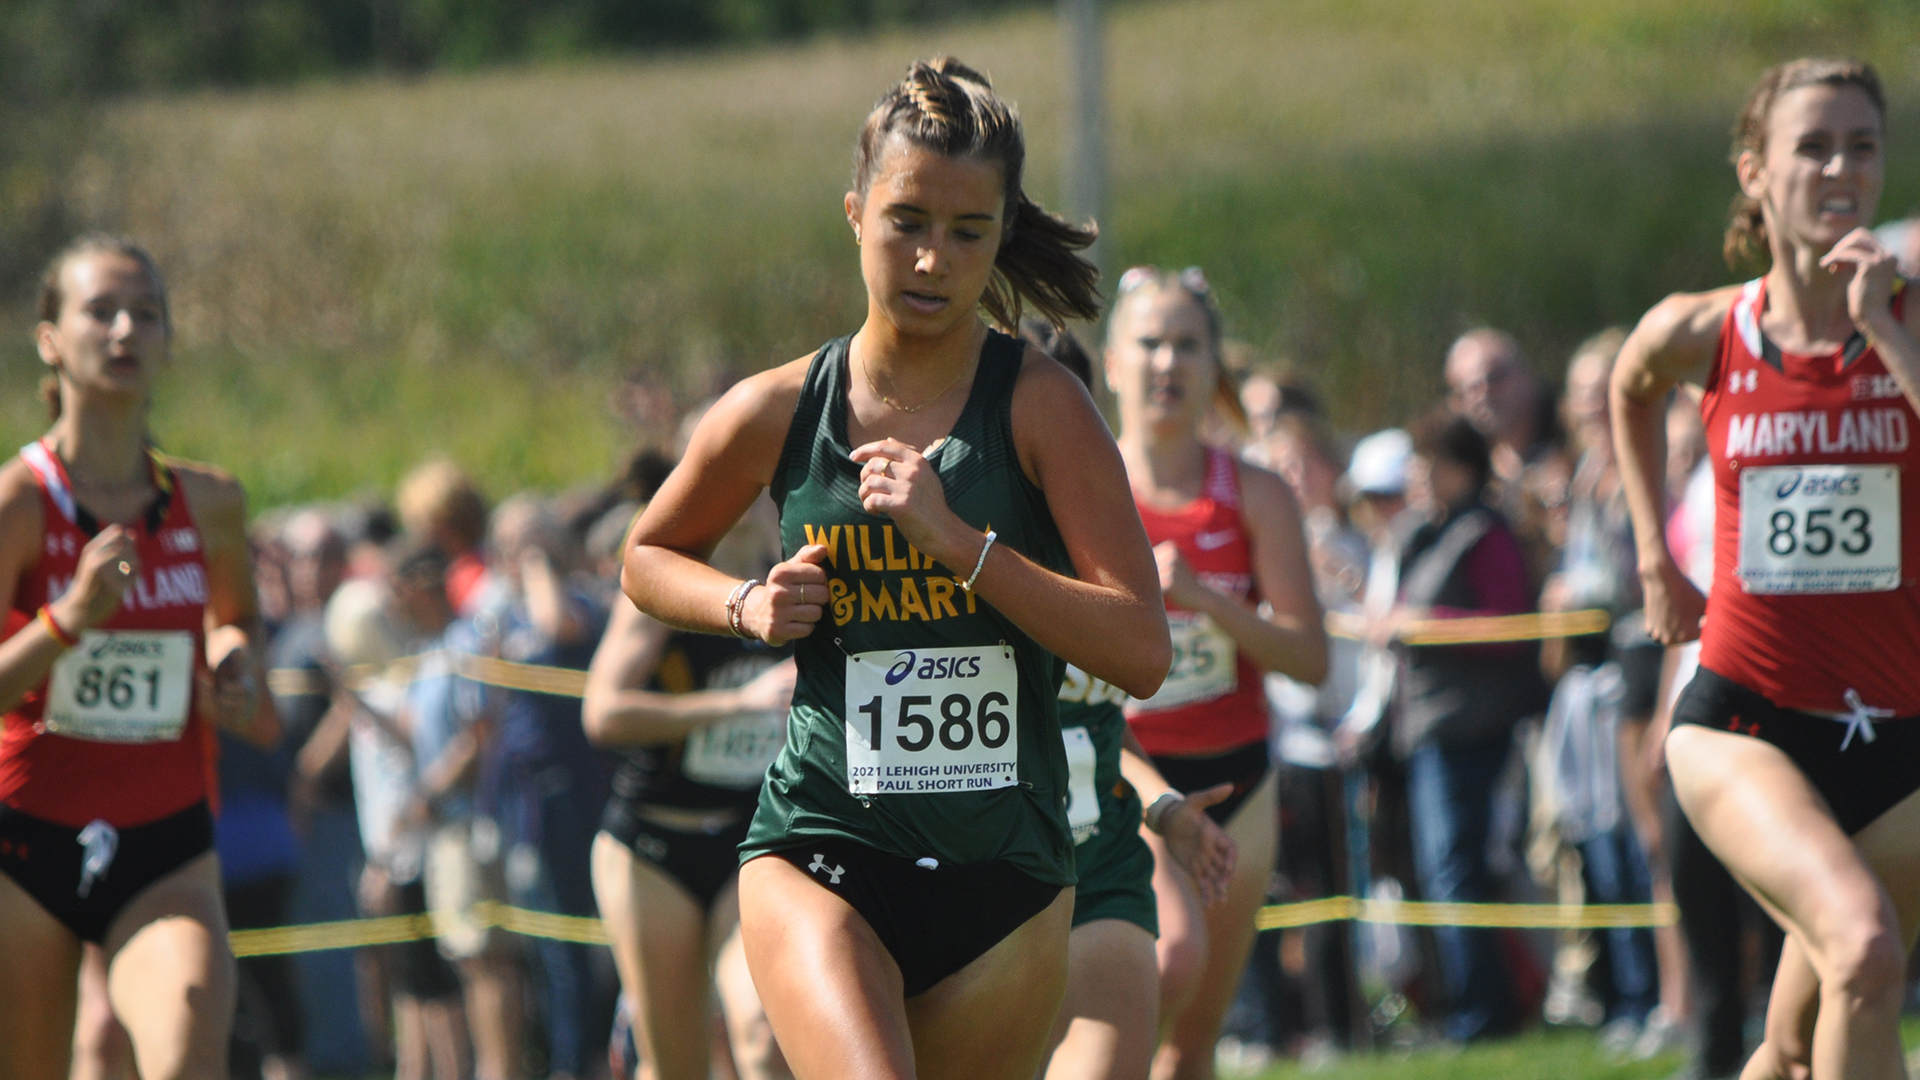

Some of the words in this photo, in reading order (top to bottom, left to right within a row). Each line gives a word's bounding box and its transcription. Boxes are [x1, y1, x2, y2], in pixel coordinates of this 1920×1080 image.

[1725, 407, 1910, 459] MARYLAND
[804, 523, 991, 571] WILLI
[1769, 508, 1872, 556] 853
[76, 666, 160, 710] 861
[858, 691, 1011, 752] 1586
[852, 766, 881, 777] 2021
[886, 765, 940, 777] LEHIGH
[943, 762, 1016, 776] UNIVERSITY
[876, 780, 914, 791] PAUL
[917, 778, 964, 790] SHORT
[966, 777, 993, 788] RUN
